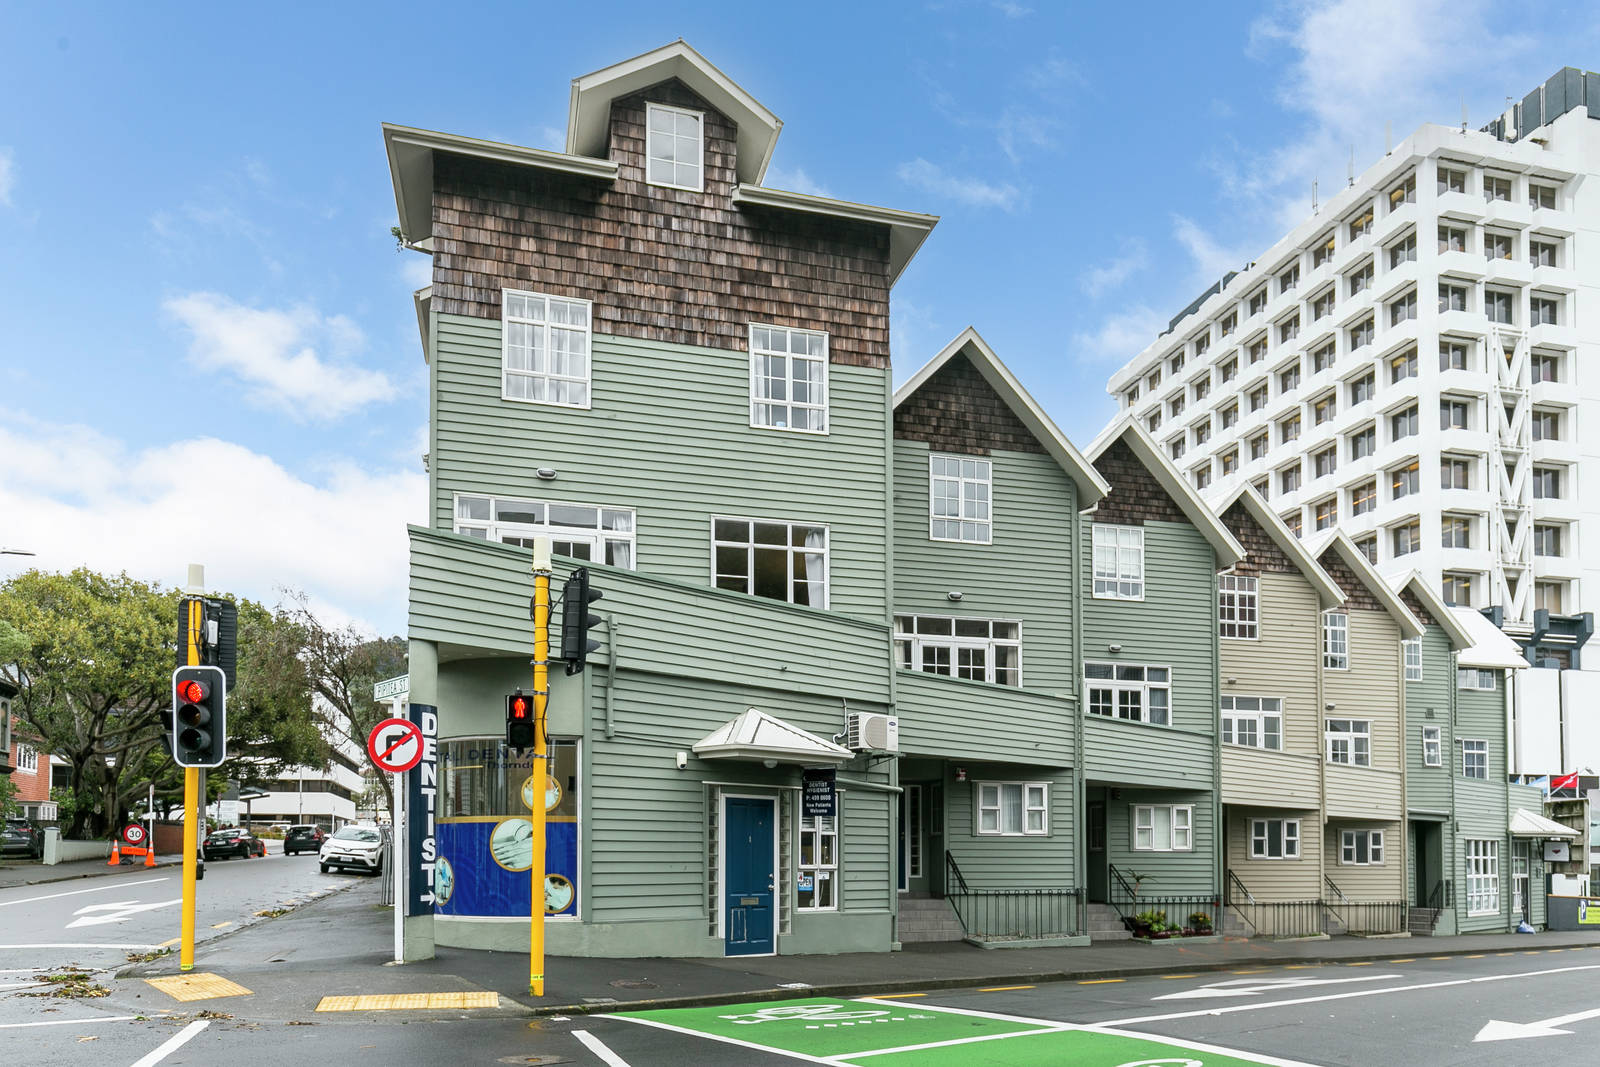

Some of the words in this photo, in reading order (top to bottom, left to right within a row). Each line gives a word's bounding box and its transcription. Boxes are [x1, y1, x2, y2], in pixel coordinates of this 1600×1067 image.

[398, 677, 407, 692] ST
[421, 712, 437, 887] DENTIST
[129, 830, 141, 838] 30
